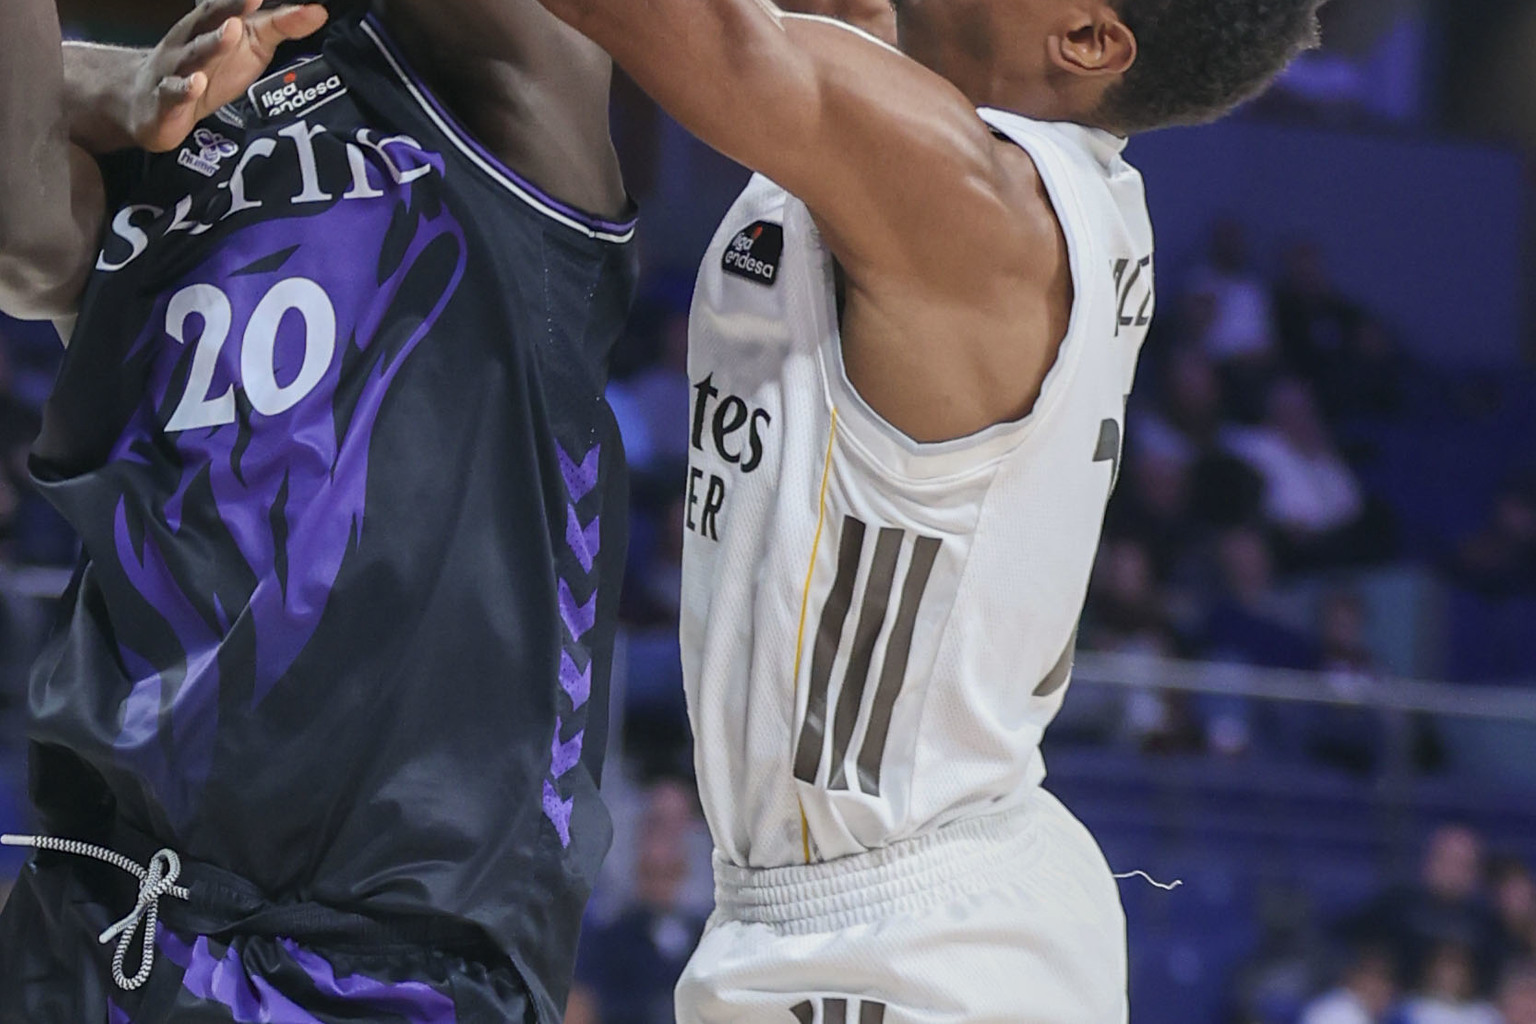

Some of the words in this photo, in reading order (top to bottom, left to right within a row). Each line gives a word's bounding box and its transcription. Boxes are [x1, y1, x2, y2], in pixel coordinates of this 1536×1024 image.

[261, 82, 298, 109] liga
[268, 75, 341, 117] endesa
[725, 251, 774, 278] endesa
[164, 277, 336, 432] 20
